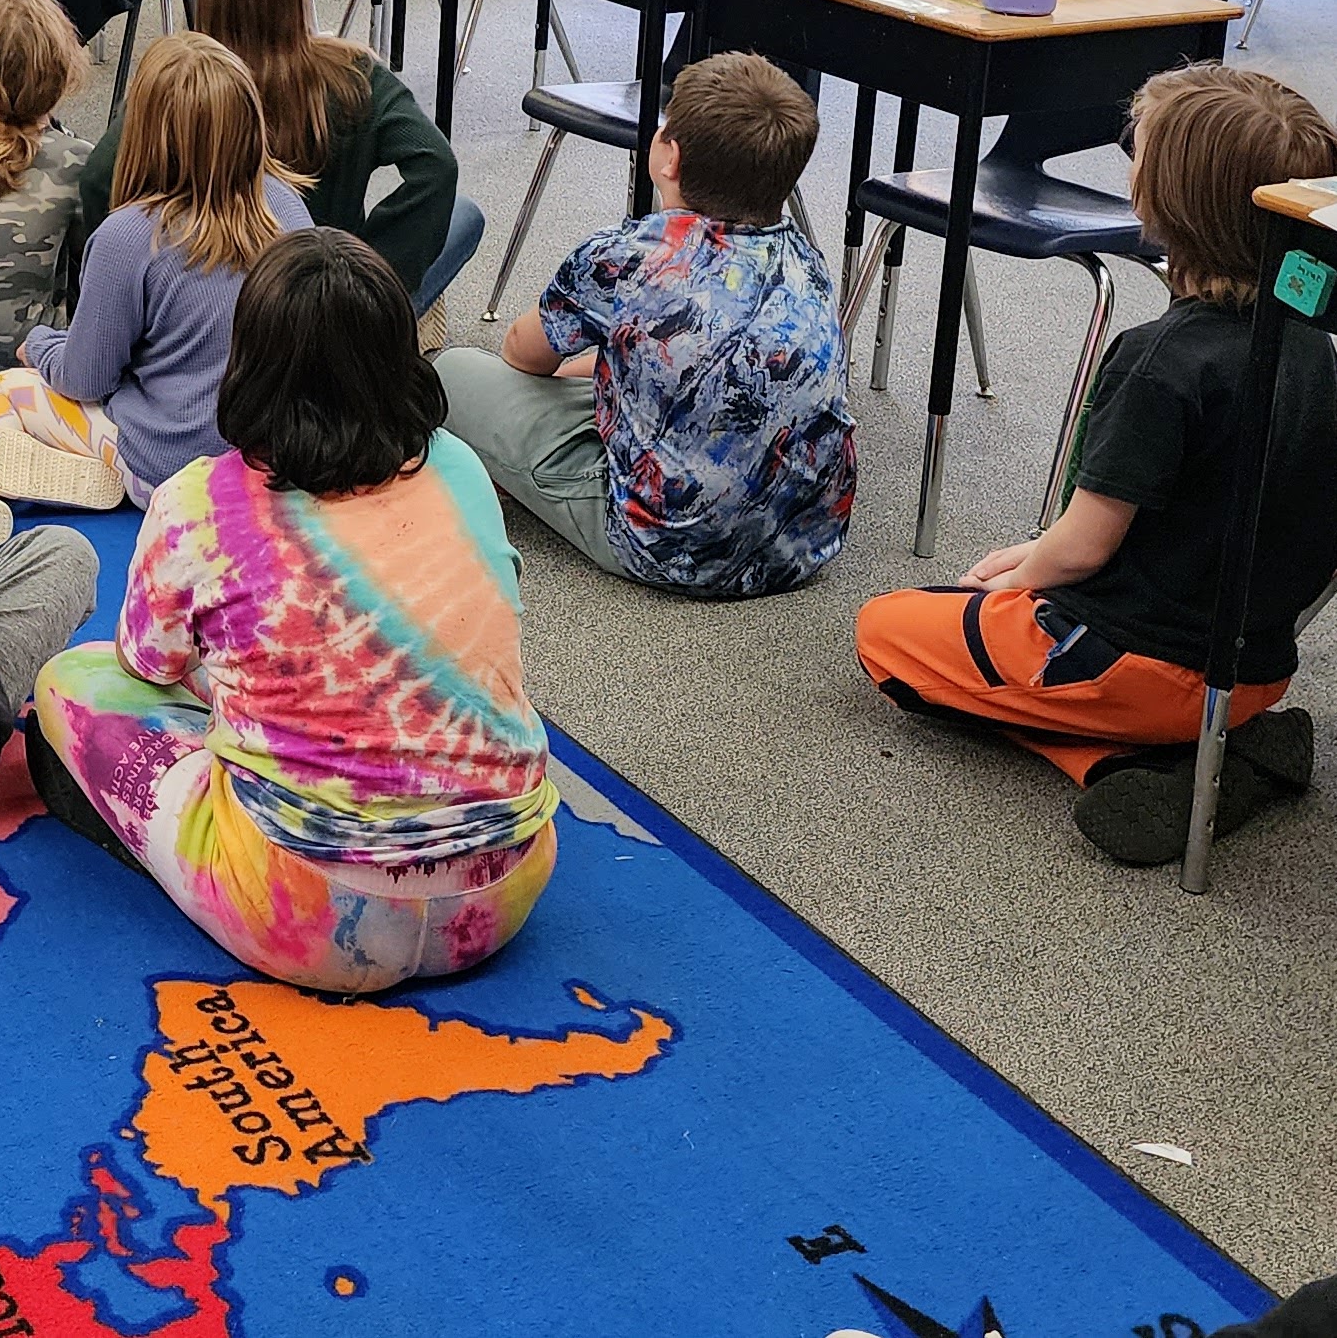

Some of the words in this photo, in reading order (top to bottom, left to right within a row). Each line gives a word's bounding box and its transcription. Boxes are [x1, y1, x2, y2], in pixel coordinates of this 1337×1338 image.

[128, 726, 161, 753] LIVE
[169, 1038, 292, 1166] South
[195, 989, 375, 1165] America
